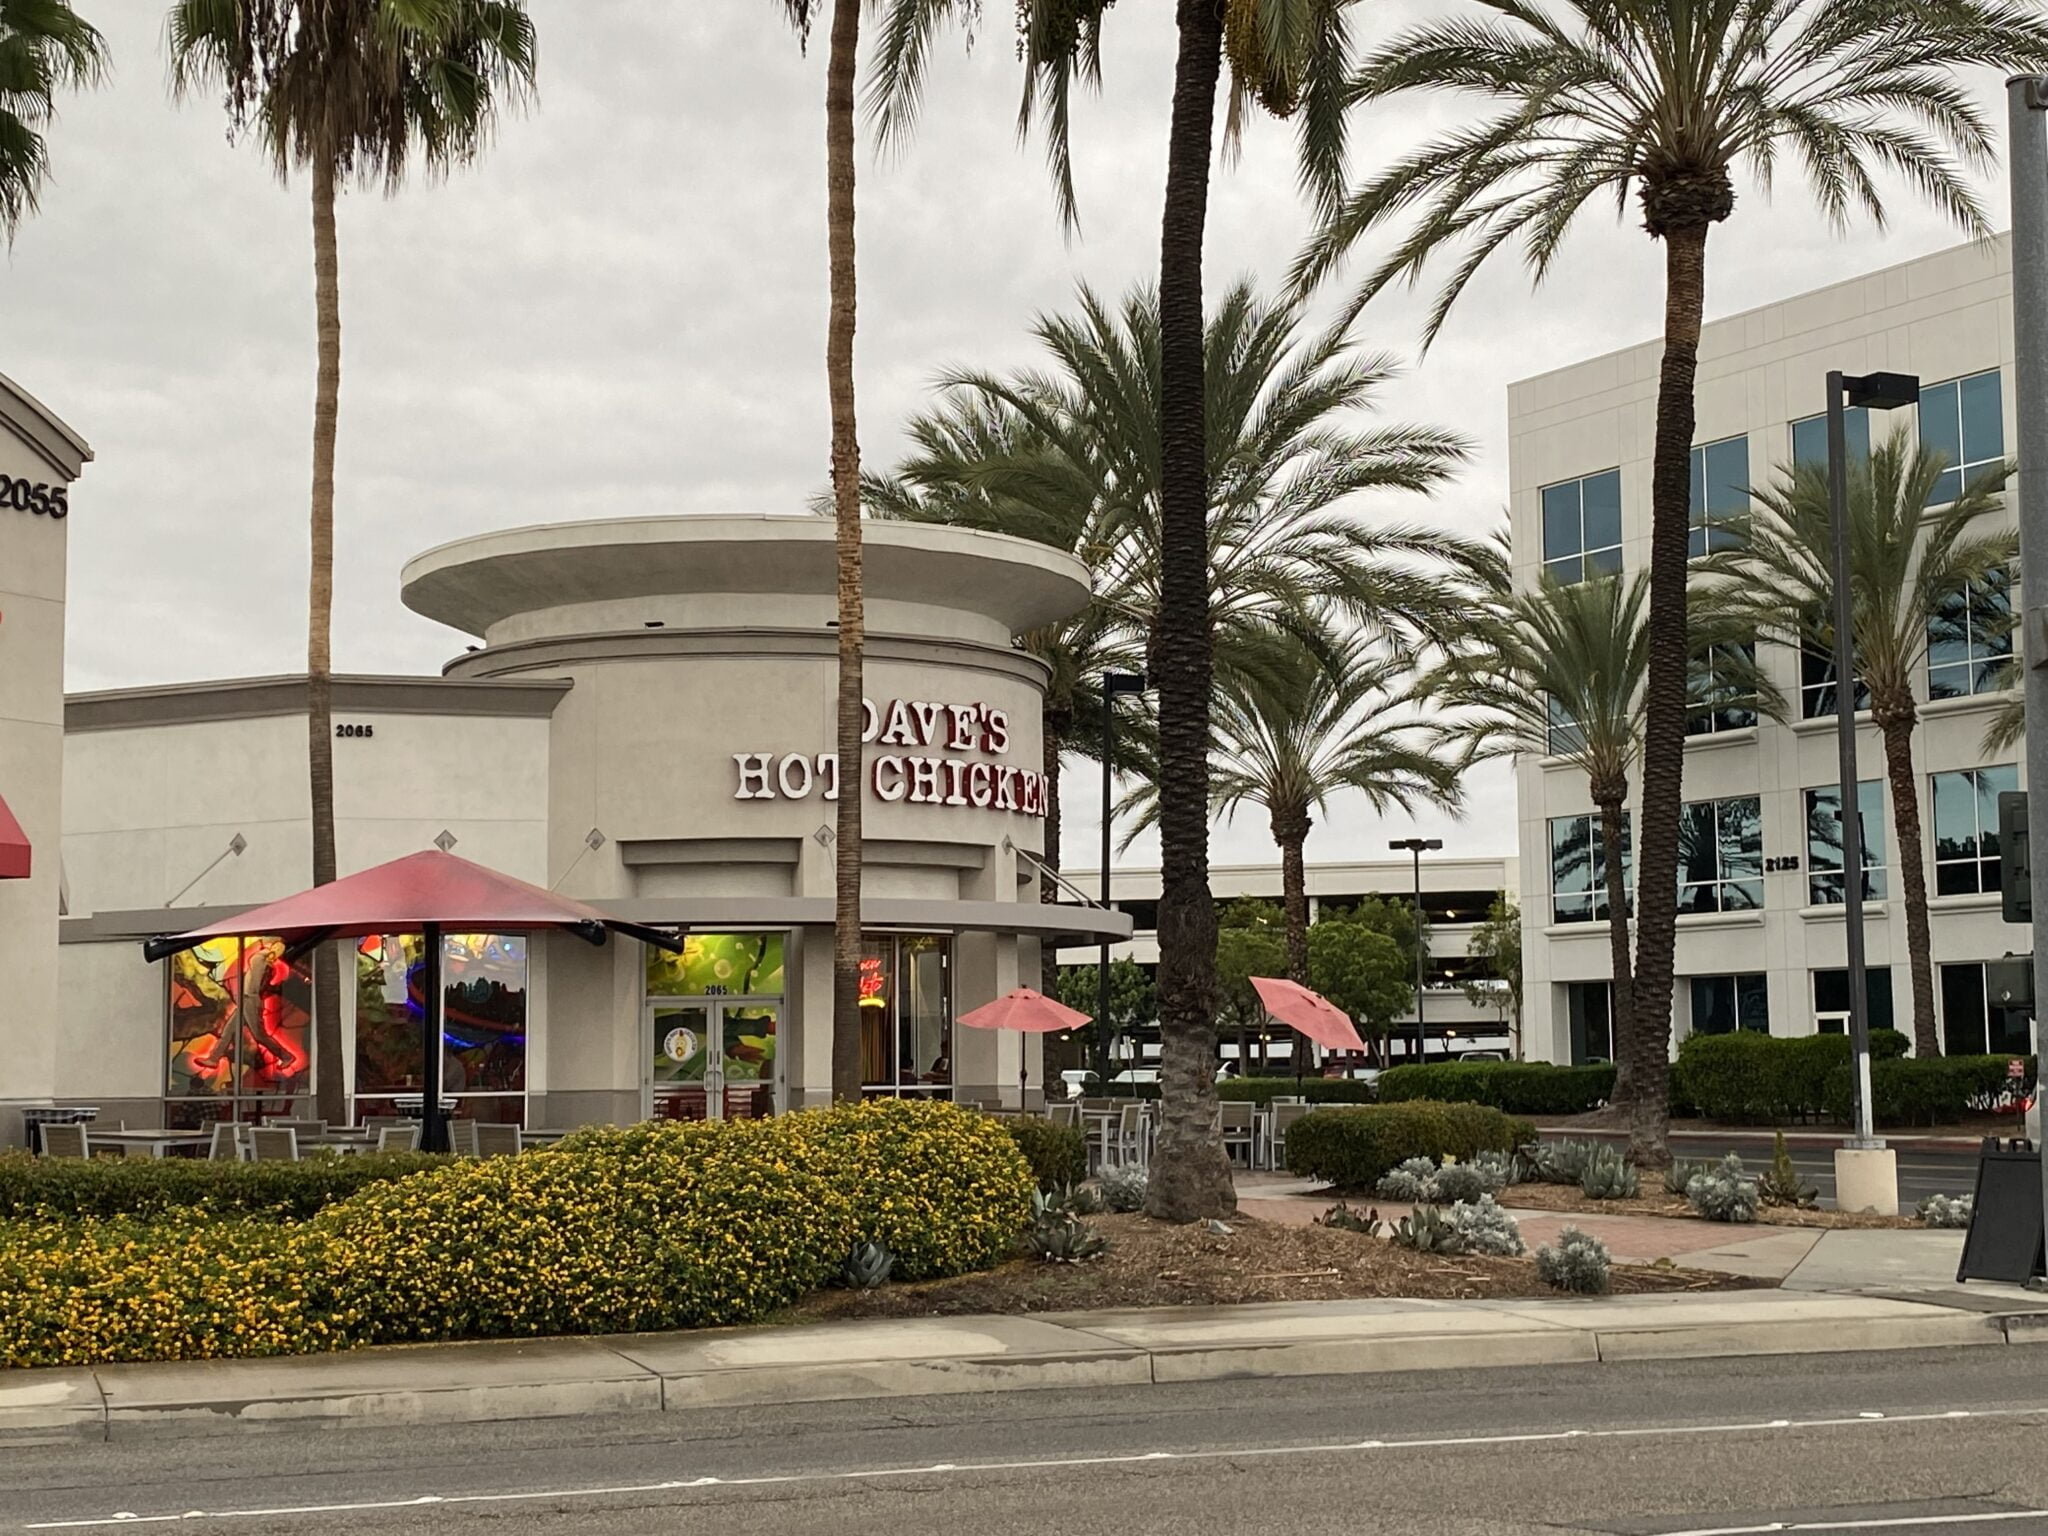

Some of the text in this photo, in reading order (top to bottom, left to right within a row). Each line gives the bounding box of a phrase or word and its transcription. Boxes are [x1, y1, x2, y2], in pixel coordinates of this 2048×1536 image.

[0, 474, 68, 519] 2055
[336, 724, 373, 737] 2065
[872, 755, 1049, 817] CHICKEN
[1765, 856, 1799, 872] 2125
[705, 985, 727, 995] 2065
